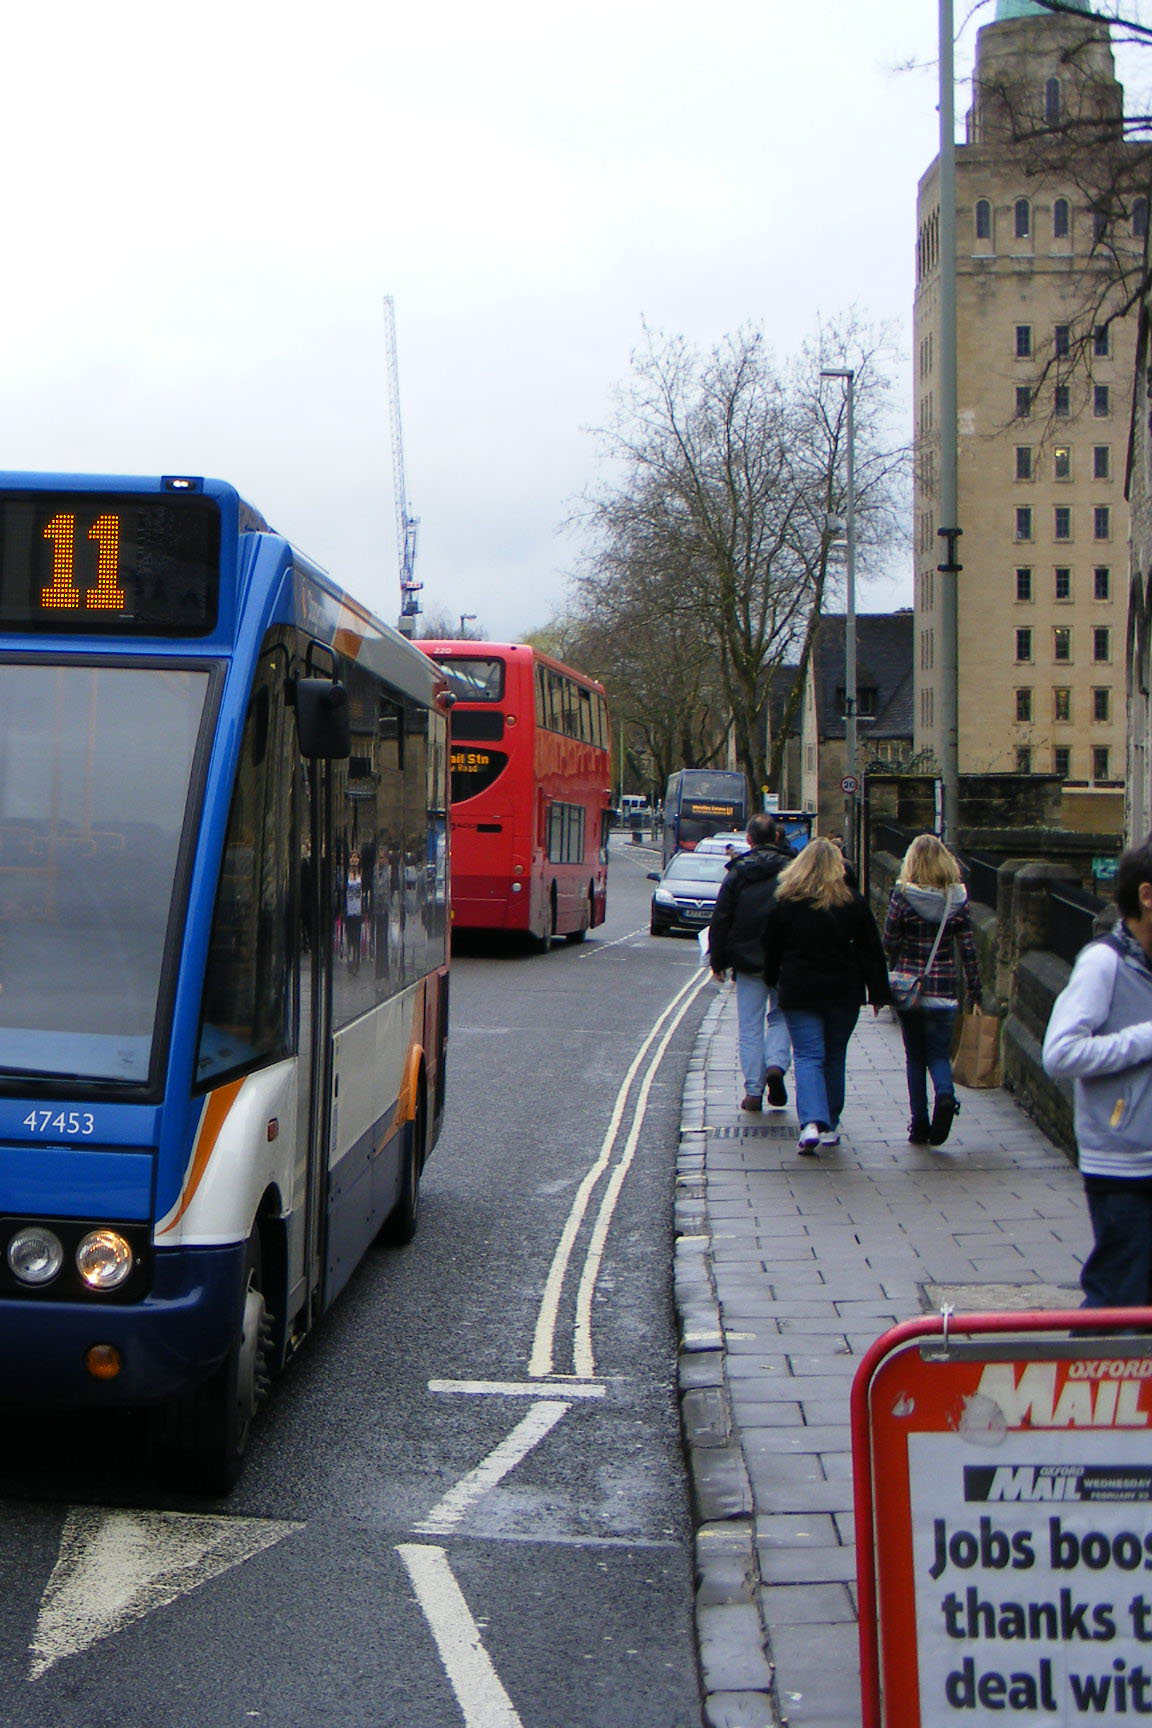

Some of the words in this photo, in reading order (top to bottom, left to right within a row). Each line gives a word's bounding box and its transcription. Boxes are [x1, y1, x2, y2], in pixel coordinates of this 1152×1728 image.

[42, 514, 124, 609] 11
[458, 764, 478, 773] Road
[467, 754, 489, 765] Stn
[22, 1110, 95, 1135] 47453
[1068, 1359, 1152, 1379] OXFORD
[963, 1362, 1148, 1427] MAIL
[987, 1466, 1081, 1501] MAIL
[1039, 1466, 1085, 1476] OXFORD
[1083, 1477, 1152, 1489] WEDNESDAY
[929, 1516, 1036, 1581] Jobs
[941, 1586, 1117, 1642] thanks
[945, 1657, 1058, 1712] deal
[1069, 1657, 1152, 1714] wit
